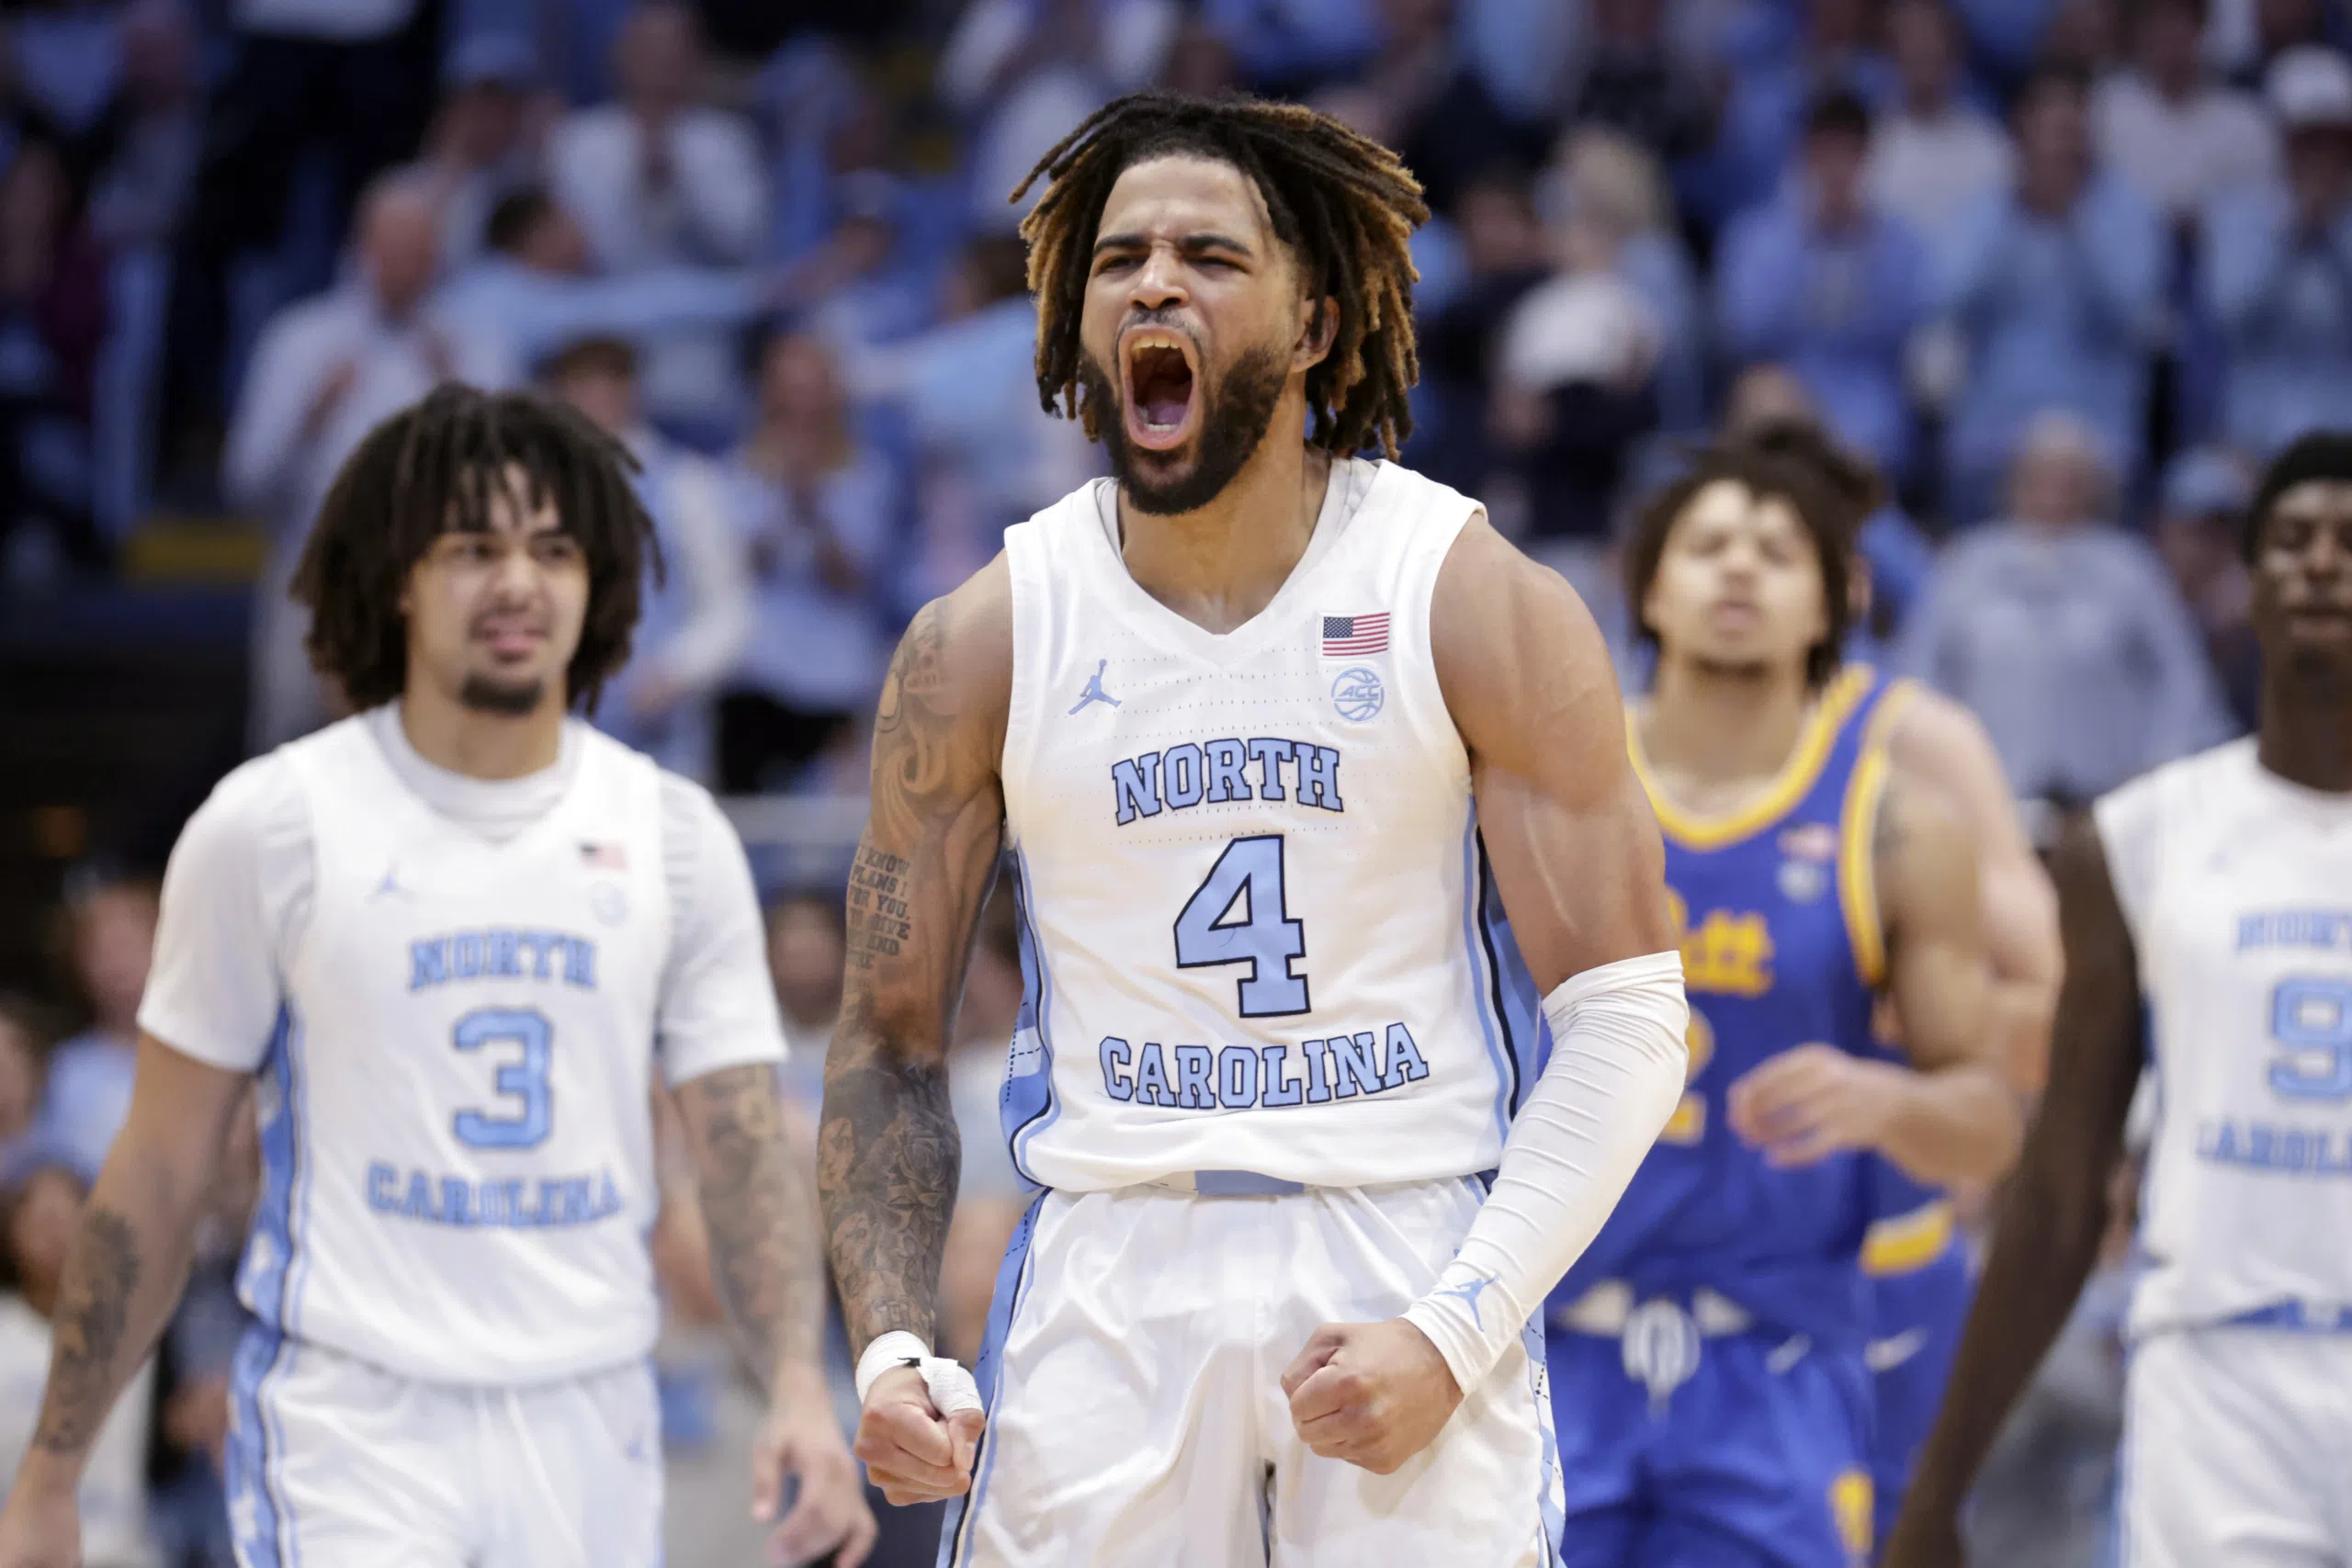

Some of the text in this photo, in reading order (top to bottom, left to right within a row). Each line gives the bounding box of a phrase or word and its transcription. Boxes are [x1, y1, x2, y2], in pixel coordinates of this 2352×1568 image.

[1337, 682, 1382, 698] ACC
[1112, 737, 1344, 826] NORTH
[409, 926, 597, 992] NORTH
[1173, 834, 1312, 1019] 4
[453, 1006, 552, 1151] 3
[1100, 1021, 1430, 1110] CAROLINA
[2267, 976, 2352, 1101] 9
[366, 1162, 626, 1229] CAROLINA
